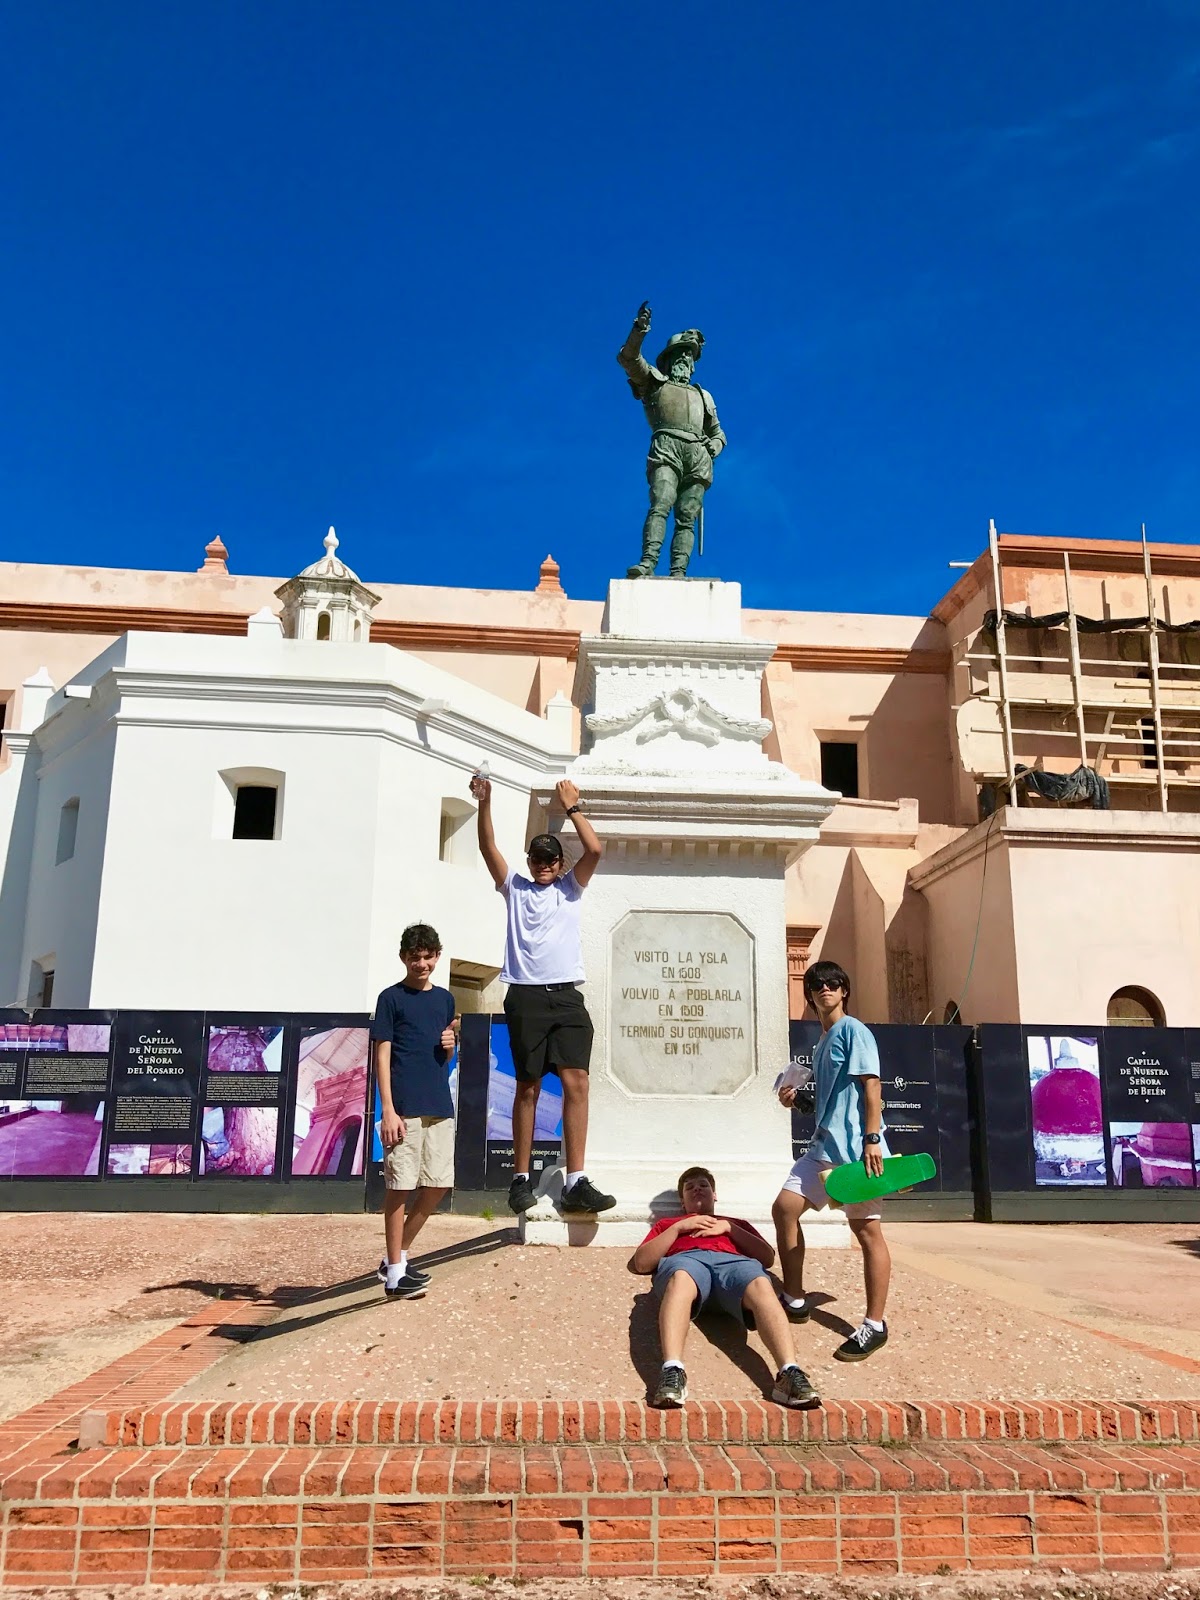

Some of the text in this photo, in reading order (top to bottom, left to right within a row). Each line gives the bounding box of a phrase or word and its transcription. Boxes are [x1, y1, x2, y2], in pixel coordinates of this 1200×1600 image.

[678, 951, 693, 964] LA
[699, 952, 728, 964] YSLA
[661, 966, 675, 979] EN
[687, 988, 742, 1002] POBLARLA
[658, 1004, 673, 1016] EN
[670, 1026, 684, 1038] SU
[688, 1026, 745, 1041] CONQUISTA
[138, 1035, 175, 1044] CAPILLA
[143, 1045, 183, 1054] NUESTRA
[664, 1042, 678, 1055] EN
[137, 1055, 173, 1064] SEÑORA
[1127, 1056, 1161, 1066] CAPILLA
[127, 1065, 185, 1075] DEL ROSARIO
[1133, 1066, 1170, 1076] NUESTRA
[1129, 1076, 1162, 1086] SEÑORA
[1141, 1086, 1167, 1096] BELÉN
